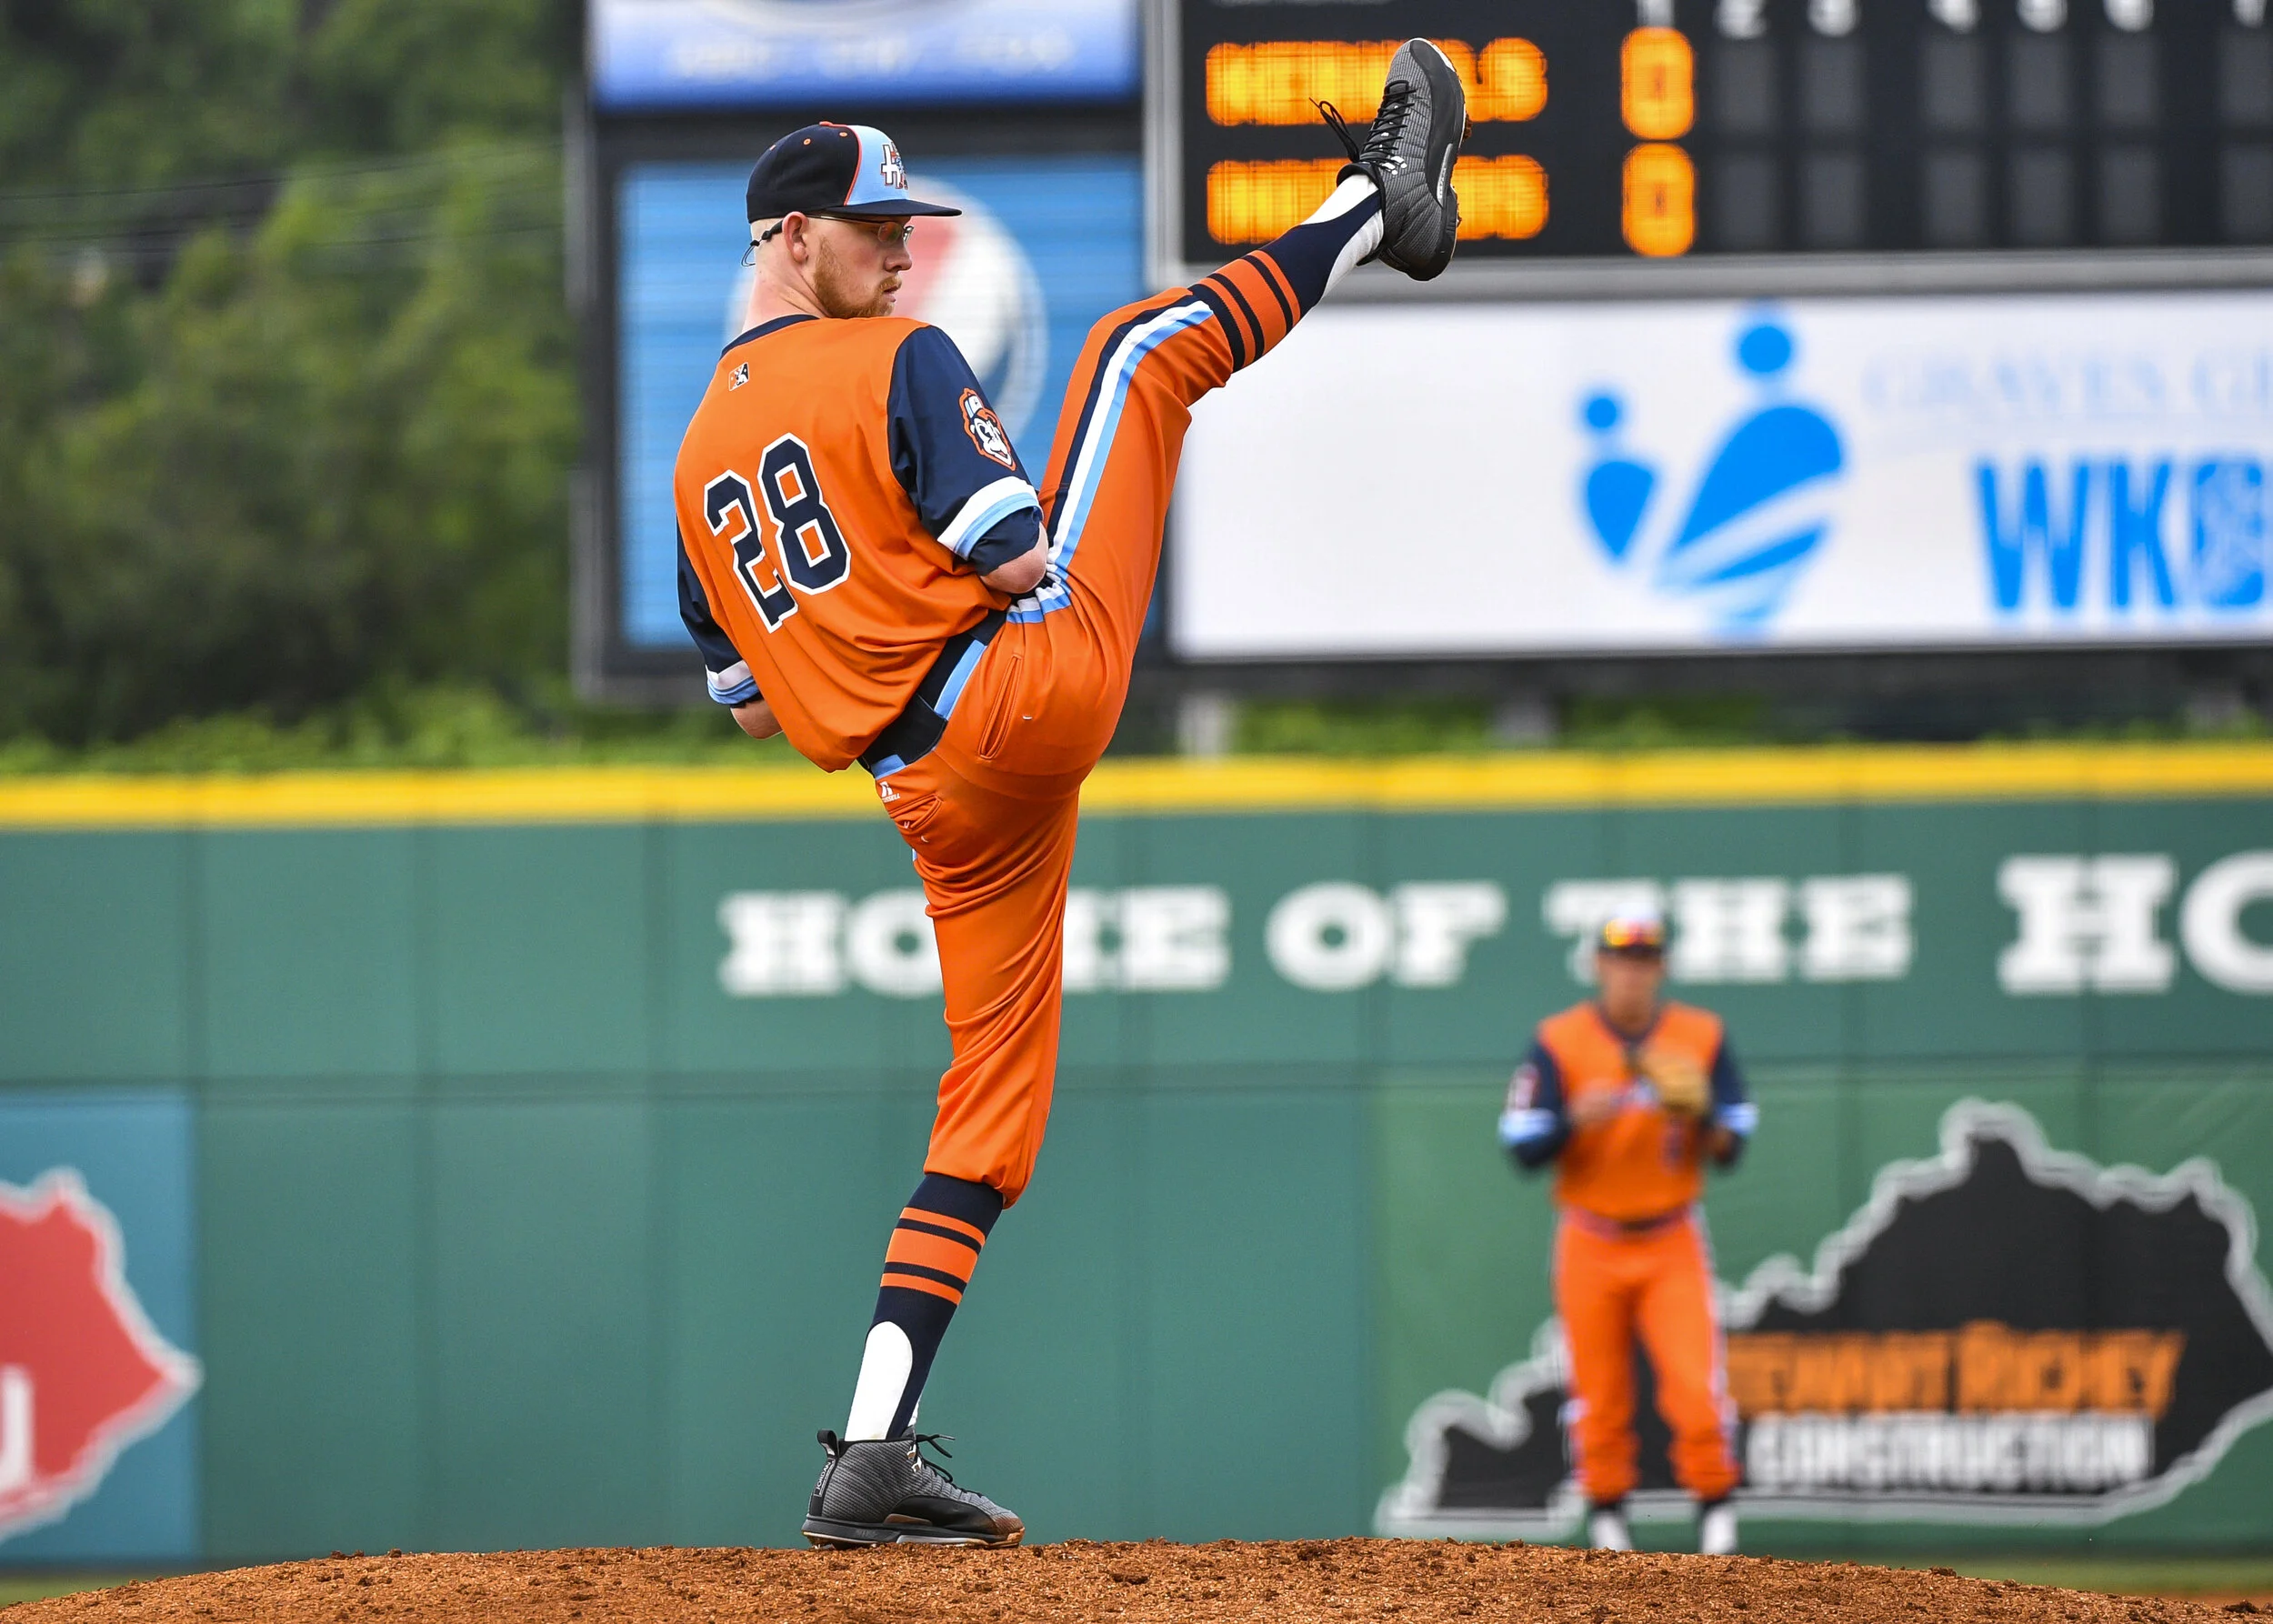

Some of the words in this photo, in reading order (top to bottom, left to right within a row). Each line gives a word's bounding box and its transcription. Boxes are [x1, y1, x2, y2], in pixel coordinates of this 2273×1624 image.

[1619, 25, 1696, 140] 0
[1621, 142, 1697, 258] 0
[703, 432, 852, 635] 28
[1266, 882, 1507, 991] OF
[1543, 875, 1912, 985] THE
[1725, 1332, 1948, 1417] TEWART
[1746, 1409, 2153, 1489] CONSTRUCTION
